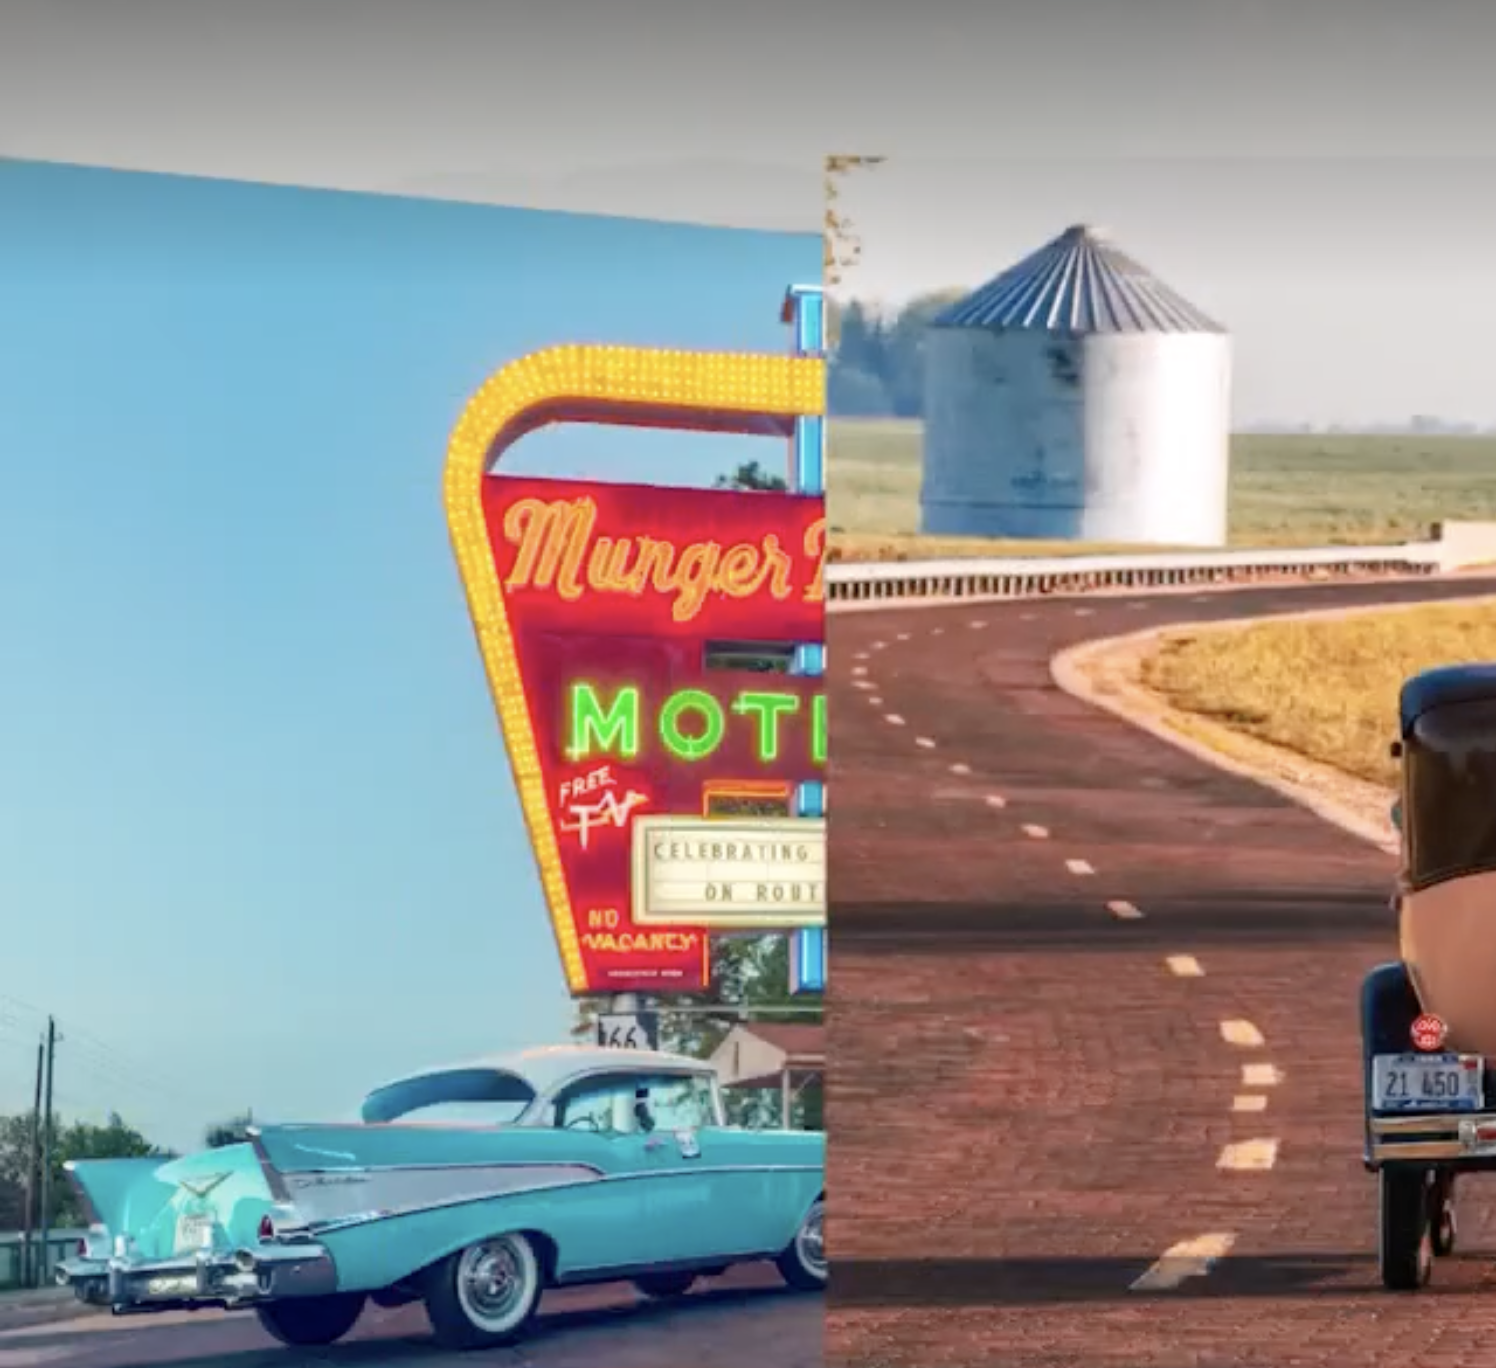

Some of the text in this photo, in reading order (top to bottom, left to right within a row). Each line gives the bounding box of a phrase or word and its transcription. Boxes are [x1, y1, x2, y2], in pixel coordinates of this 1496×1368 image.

[504, 496, 792, 622] Munger
[560, 765, 617, 808] FREE
[654, 842, 808, 862] CELEBRATING
[704, 883, 818, 902] ON ROUT
[588, 908, 619, 930] NO
[581, 933, 698, 953] VACANCY
[610, 1024, 637, 1048] 66
[1386, 1071, 1460, 1098] 21 450
